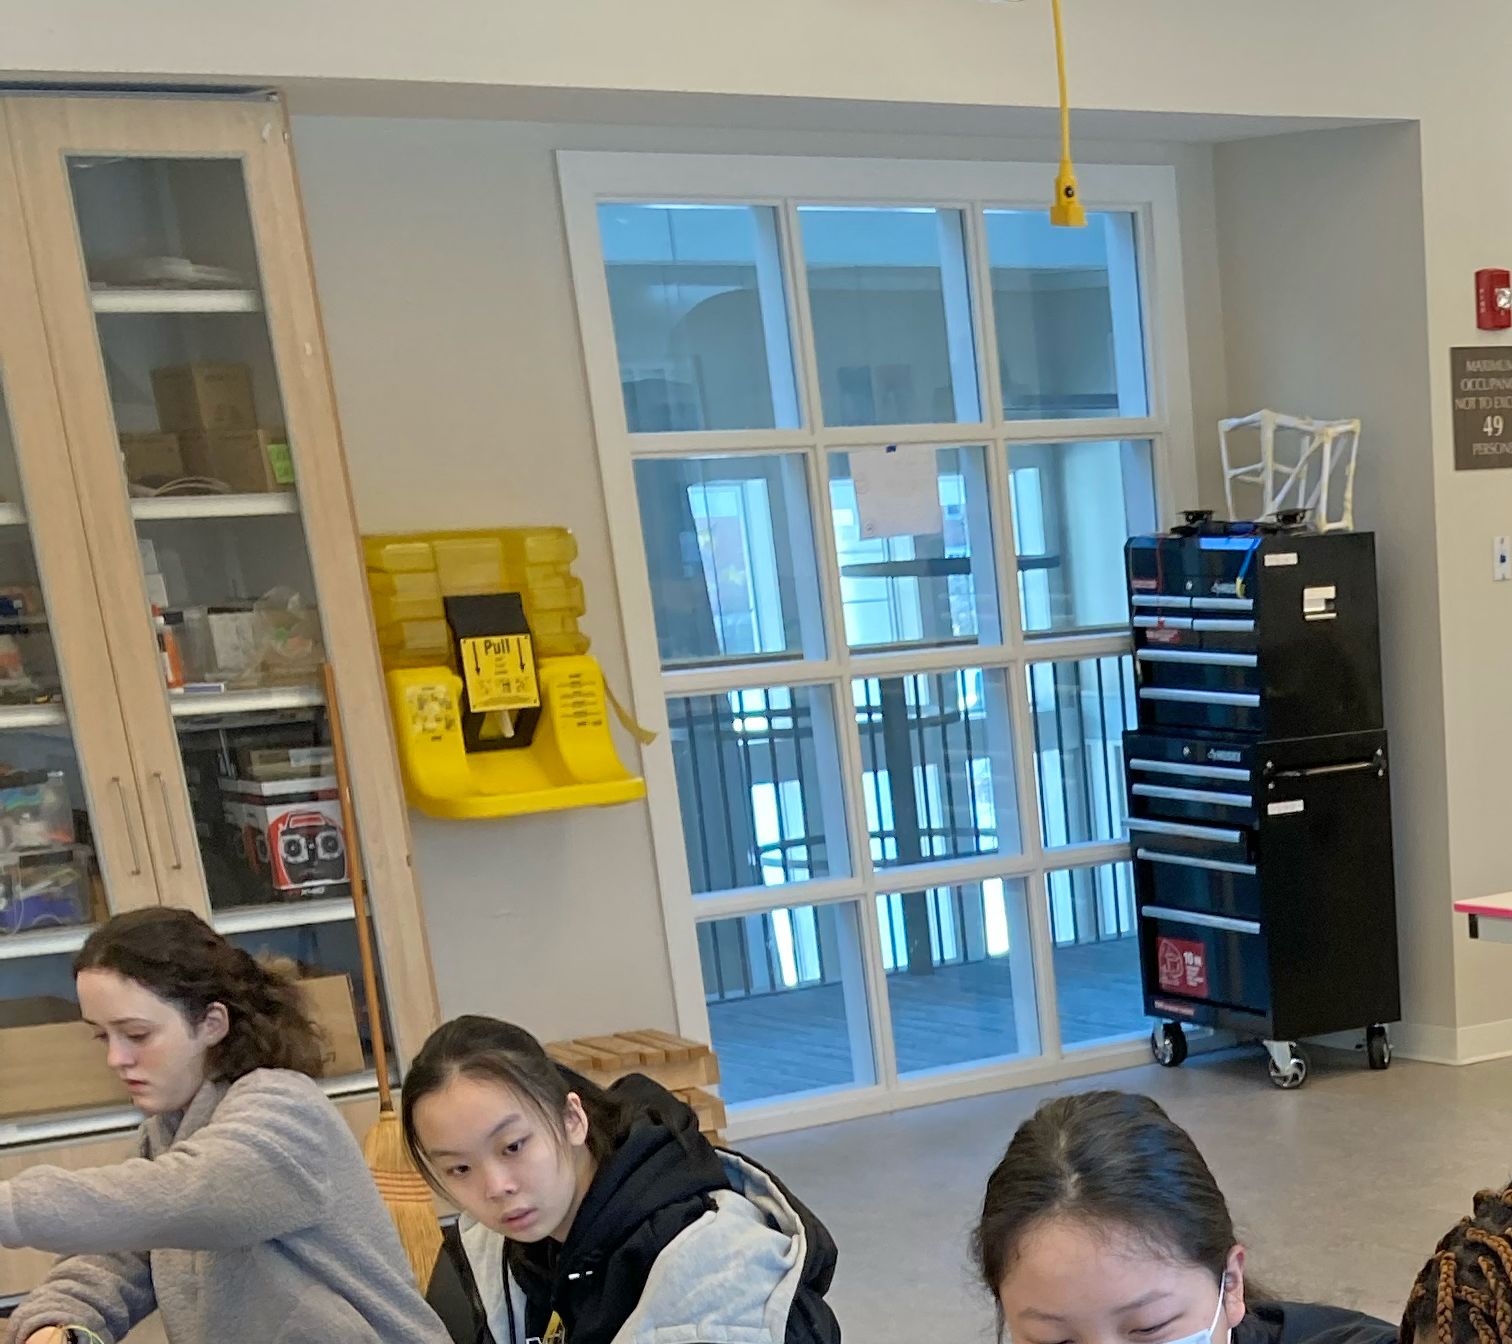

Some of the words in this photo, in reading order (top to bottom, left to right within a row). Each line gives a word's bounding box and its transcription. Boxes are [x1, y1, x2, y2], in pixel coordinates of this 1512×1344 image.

[1455, 397, 1476, 410] NOT
[1478, 397, 1493, 409] TO
[1482, 415, 1504, 436] 49
[484, 638, 510, 656] Pull
